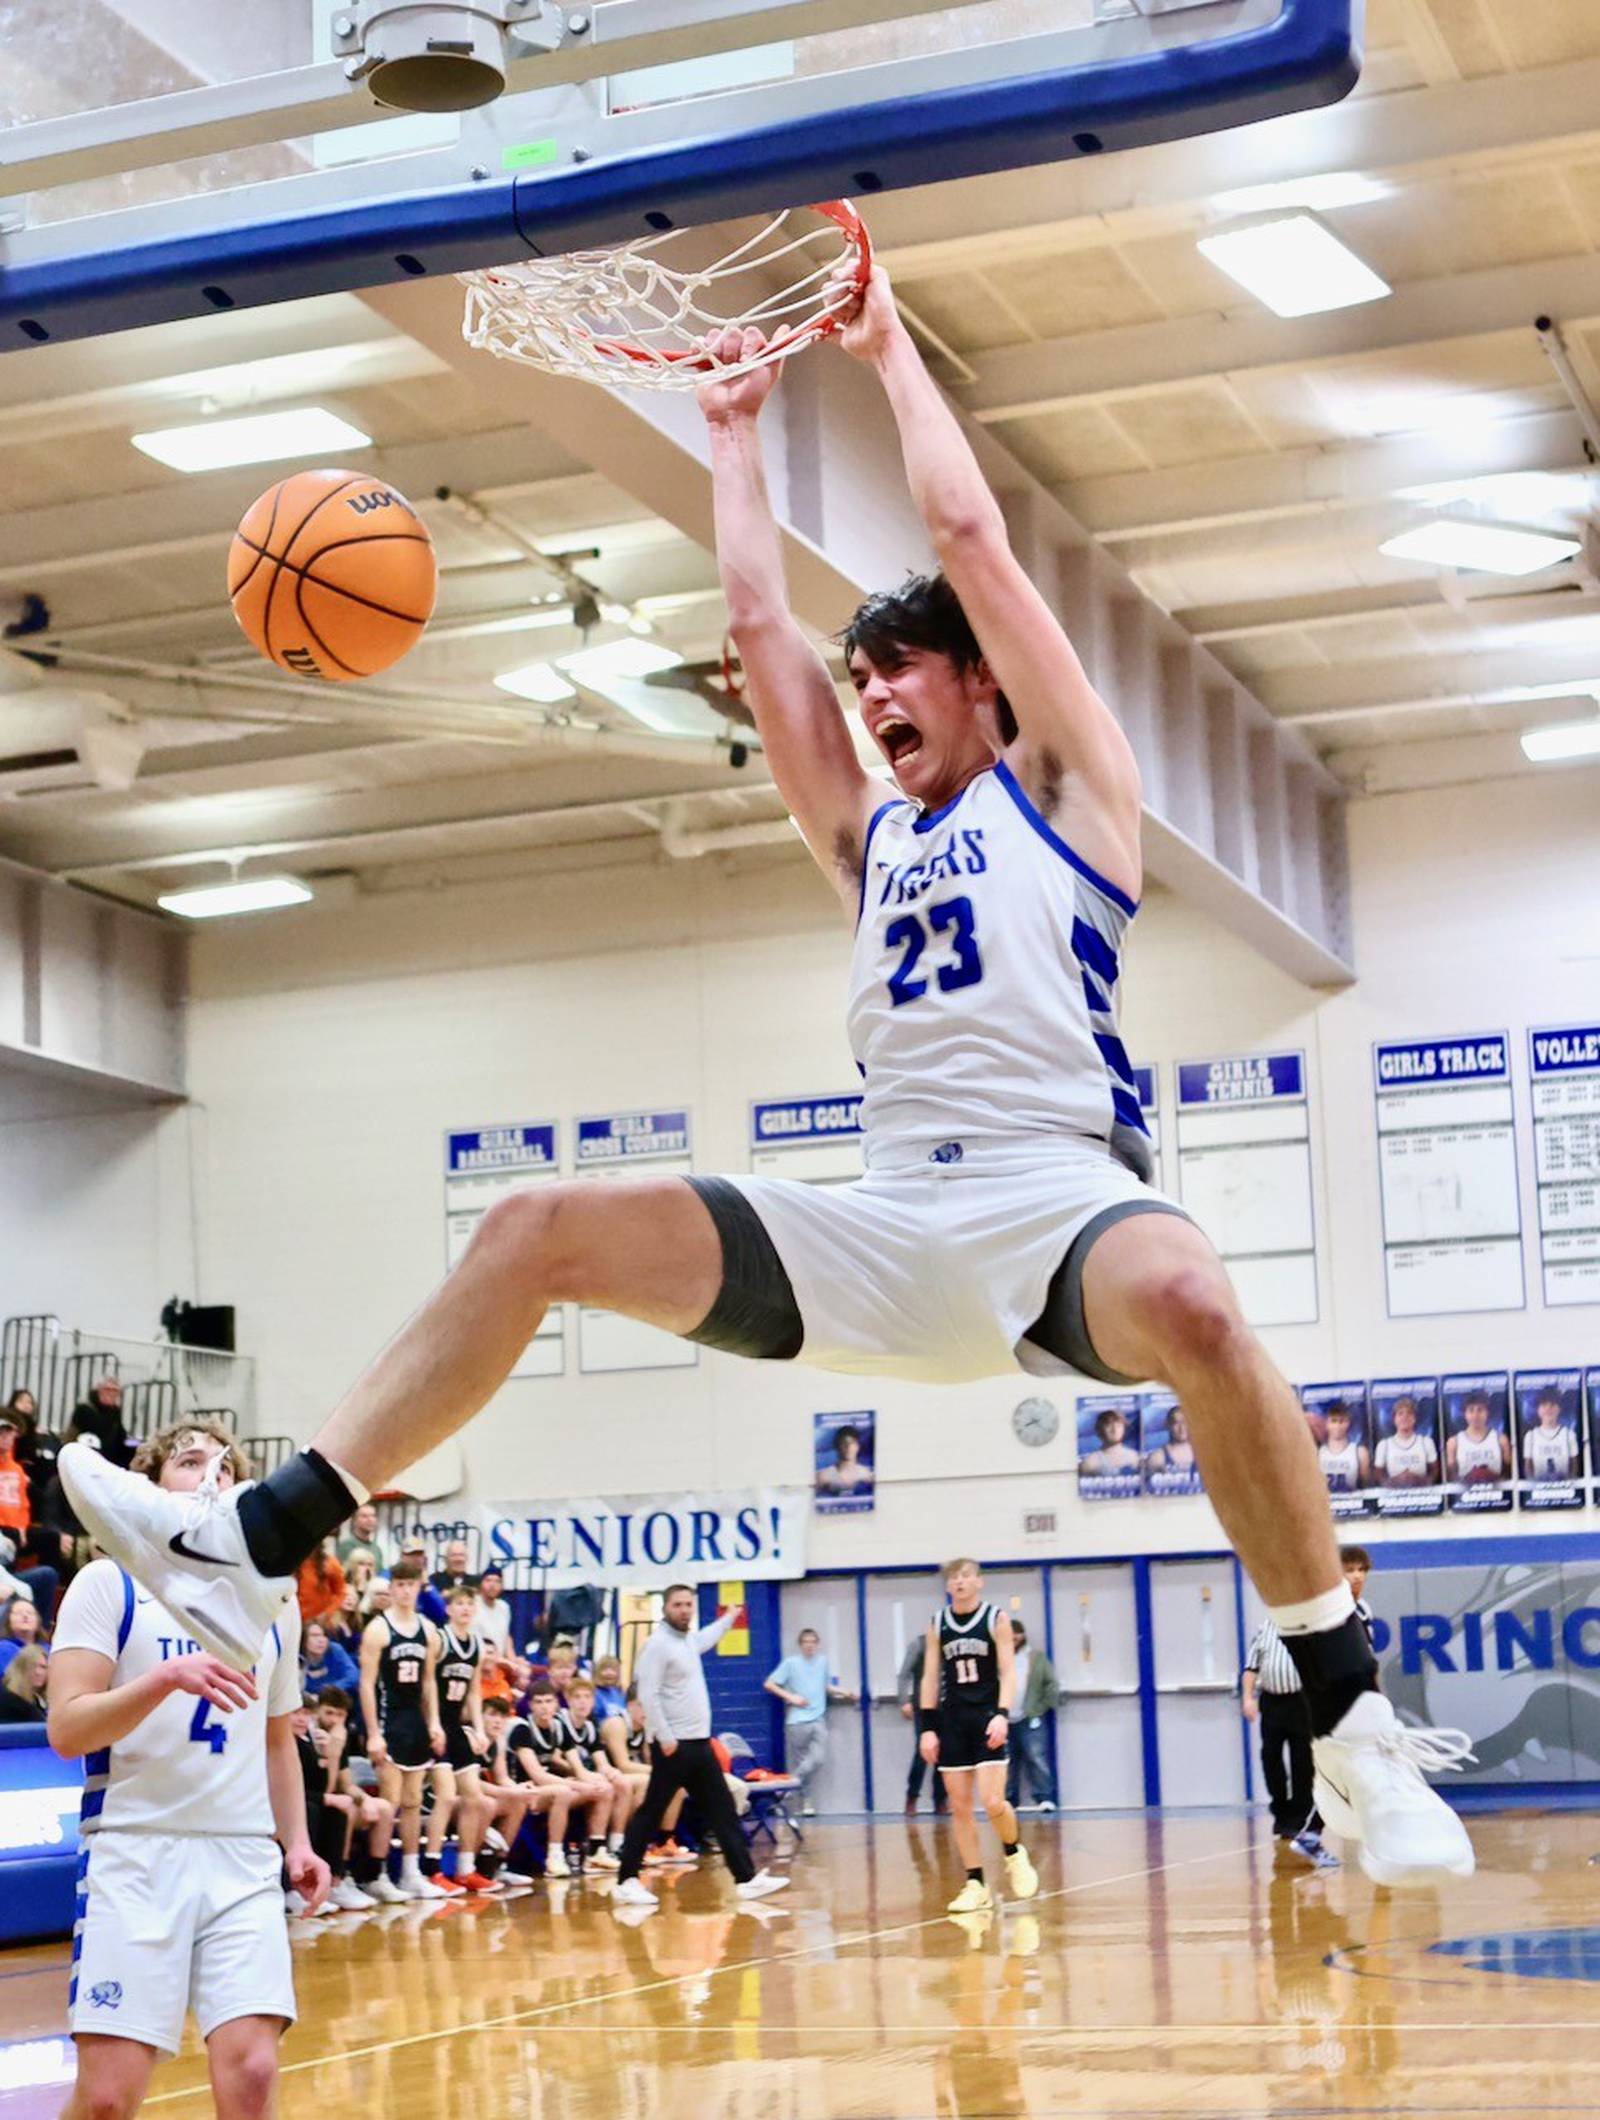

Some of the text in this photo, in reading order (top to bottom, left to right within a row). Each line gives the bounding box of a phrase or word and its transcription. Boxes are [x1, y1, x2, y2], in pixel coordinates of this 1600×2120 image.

[885, 895, 984, 1007] 23
[1380, 1043, 1504, 1079] GIRLS TRACK
[1534, 1034, 1600, 1065] VOLLE
[1209, 1058, 1269, 1082] GIRLS
[1206, 1076, 1274, 1101] TENNIS
[760, 1107, 812, 1135] GIRLS
[490, 1507, 780, 1569] SENIORS!
[955, 1658, 980, 1684] 11
[189, 1690, 227, 1754] 4
